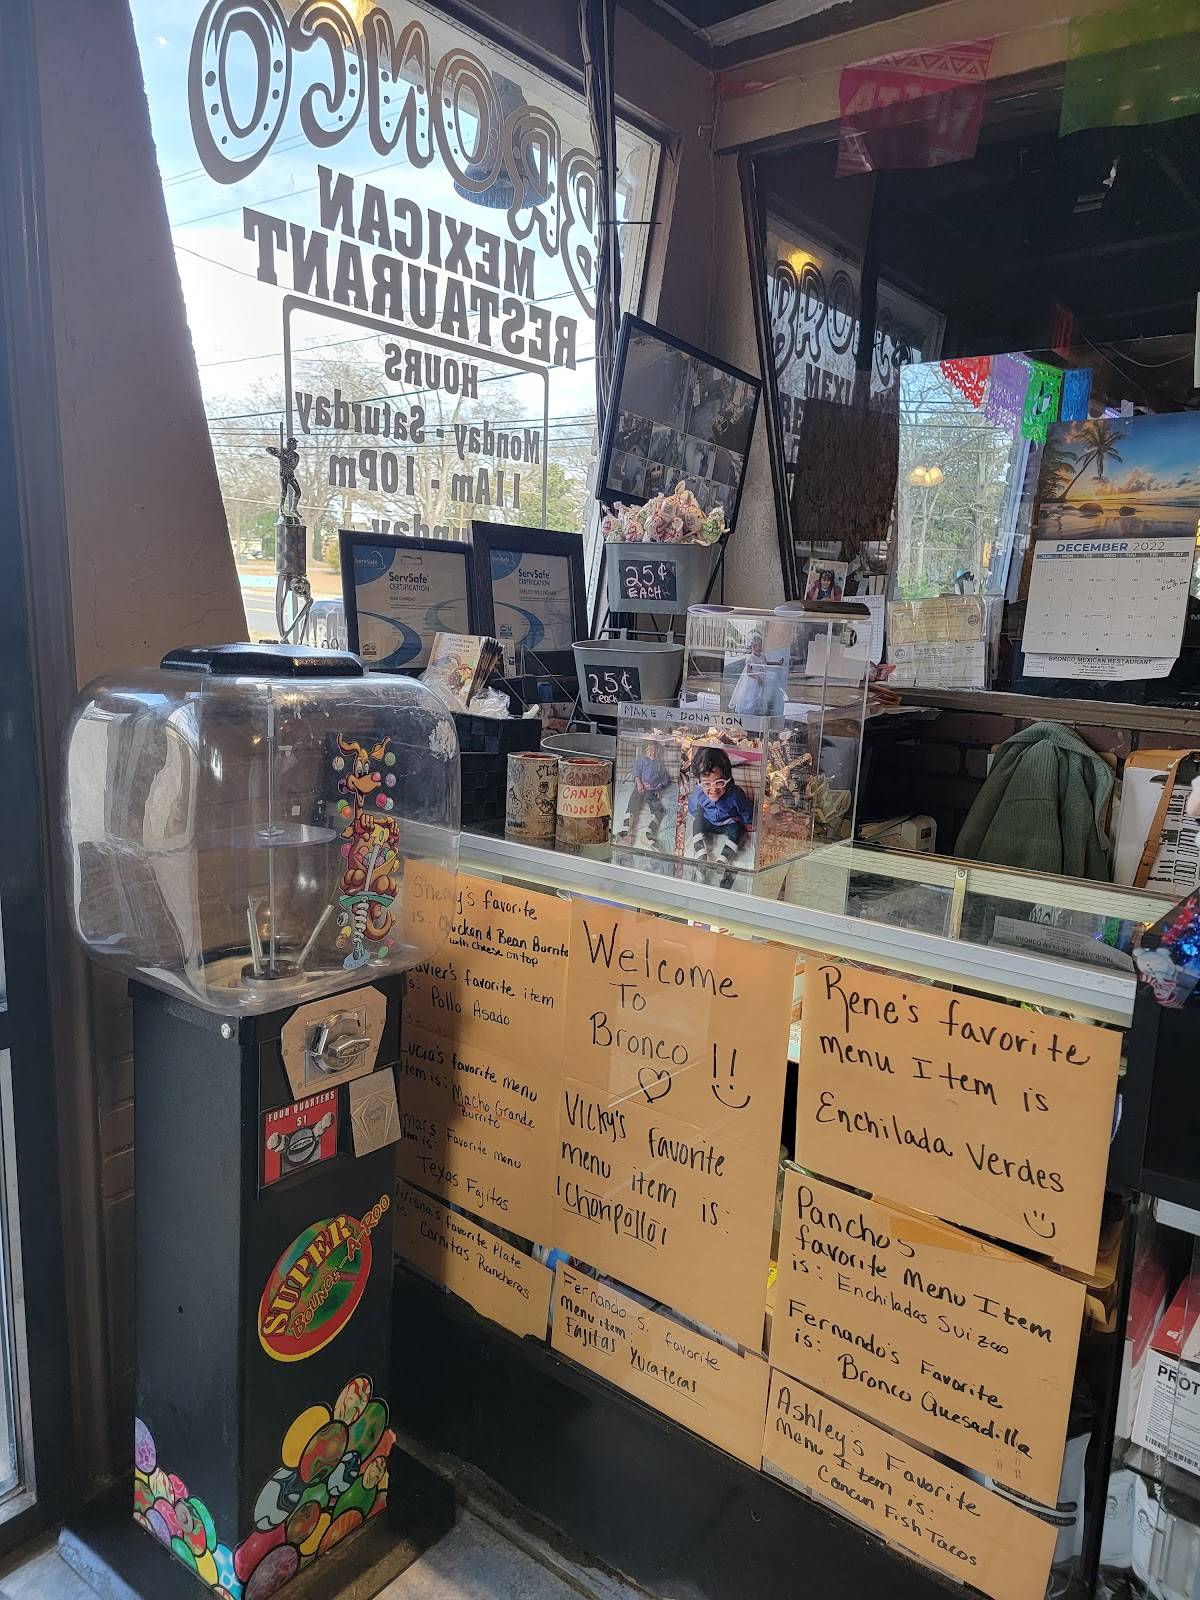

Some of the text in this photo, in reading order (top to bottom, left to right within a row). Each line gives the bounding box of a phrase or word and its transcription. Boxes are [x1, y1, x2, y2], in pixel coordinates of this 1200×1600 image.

[1055, 541, 1166, 552] DECEMBER 2022
[388, 571, 428, 584] ServSafe
[389, 583, 430, 593] CERTIFICATION
[518, 568, 551, 579] ServSafe
[518, 579, 551, 587] CERTIFICATION
[624, 562, 668, 588] 25¢
[628, 587, 663, 600] EACH
[588, 670, 634, 695] 25¢
[1048, 655, 1076, 663] BRONCO
[624, 705, 657, 719] MAKE
[664, 709, 674, 720] A
[484, 890, 538, 920] favorite
[496, 928, 527, 950] Bean
[582, 919, 739, 998] Welcome
[408, 962, 554, 1009] avier's favorite item
[431, 985, 462, 1013] Pollo
[473, 1000, 511, 1026] Asado
[608, 982, 647, 1011] To
[589, 1011, 689, 1066] Bronco
[817, 965, 1091, 1066] Rene's favorite
[452, 1052, 498, 1084] favorite
[911, 1056, 998, 1106] Item
[1022, 1087, 1050, 1113] is
[268, 1090, 336, 1124] FOUR QUARTERS
[495, 1100, 536, 1129] Grande
[815, 1090, 1066, 1194] Enchilada Verdes
[416, 1155, 509, 1211] Texas Fajitas
[561, 1140, 612, 1179] menu
[631, 1165, 678, 1209] item
[262, 1215, 352, 1337] SUPER
[419, 1220, 531, 1300] Carnitas Rancheras
[493, 1241, 523, 1270] Plate
[791, 1253, 824, 1280] is:
[836, 1271, 929, 1325] Enchiladas
[795, 1223, 888, 1279] favorite
[973, 1293, 1052, 1343] Item
[562, 1271, 721, 1371] Fernando S. favorite
[564, 1315, 698, 1393] Fajitas Yucatecas
[787, 1298, 1004, 1410] Fernando's Favorite
[794, 1328, 1033, 1460] is: Bronco Quesadilla
[775, 1416, 824, 1456] Menu
[833, 1455, 893, 1497] Item
[907, 1494, 935, 1522] is:
[776, 1385, 982, 1518] Ashley's Favorite
[817, 1463, 875, 1511] Cancun
[884, 1503, 922, 1537] Fish
[924, 1527, 978, 1567] Tacos
